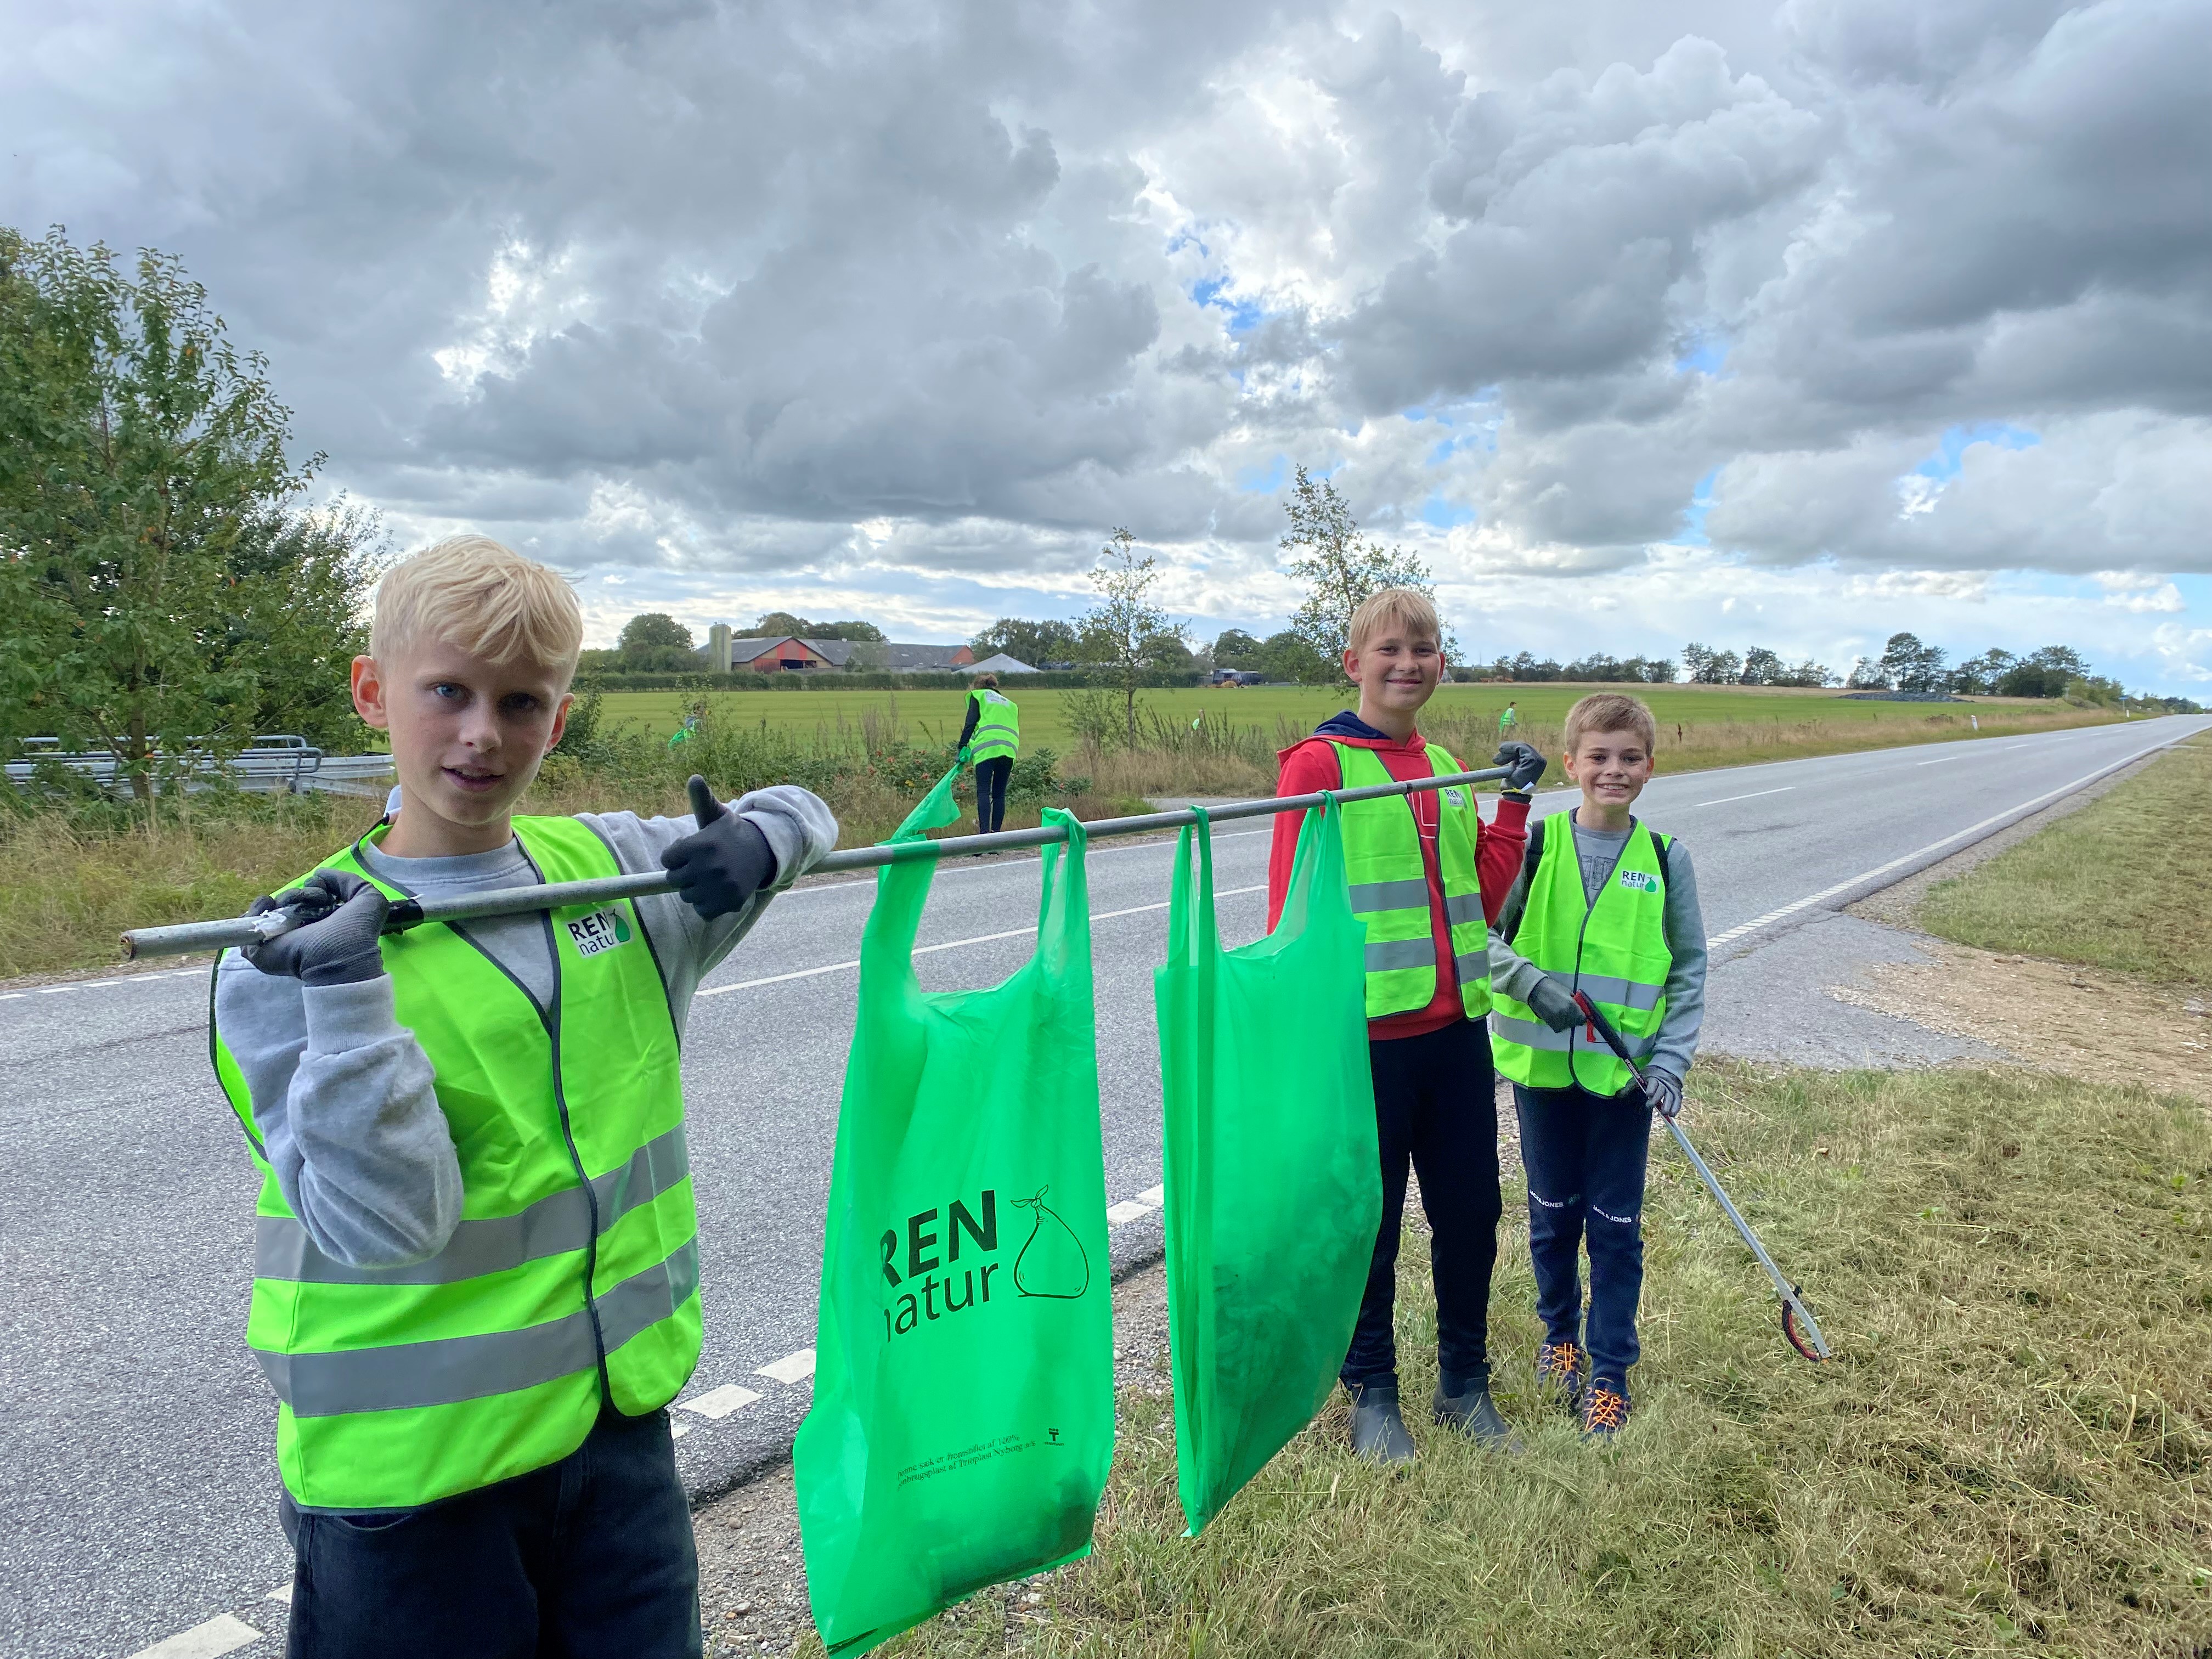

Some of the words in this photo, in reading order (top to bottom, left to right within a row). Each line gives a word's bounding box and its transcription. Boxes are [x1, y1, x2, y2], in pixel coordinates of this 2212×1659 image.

[1444, 789, 1461, 799] REN
[1622, 871, 1645, 882] REN
[1622, 880, 1644, 889] natur
[567, 911, 611, 941] REN
[578, 933, 614, 955] natu
[881, 1189, 998, 1288] REN
